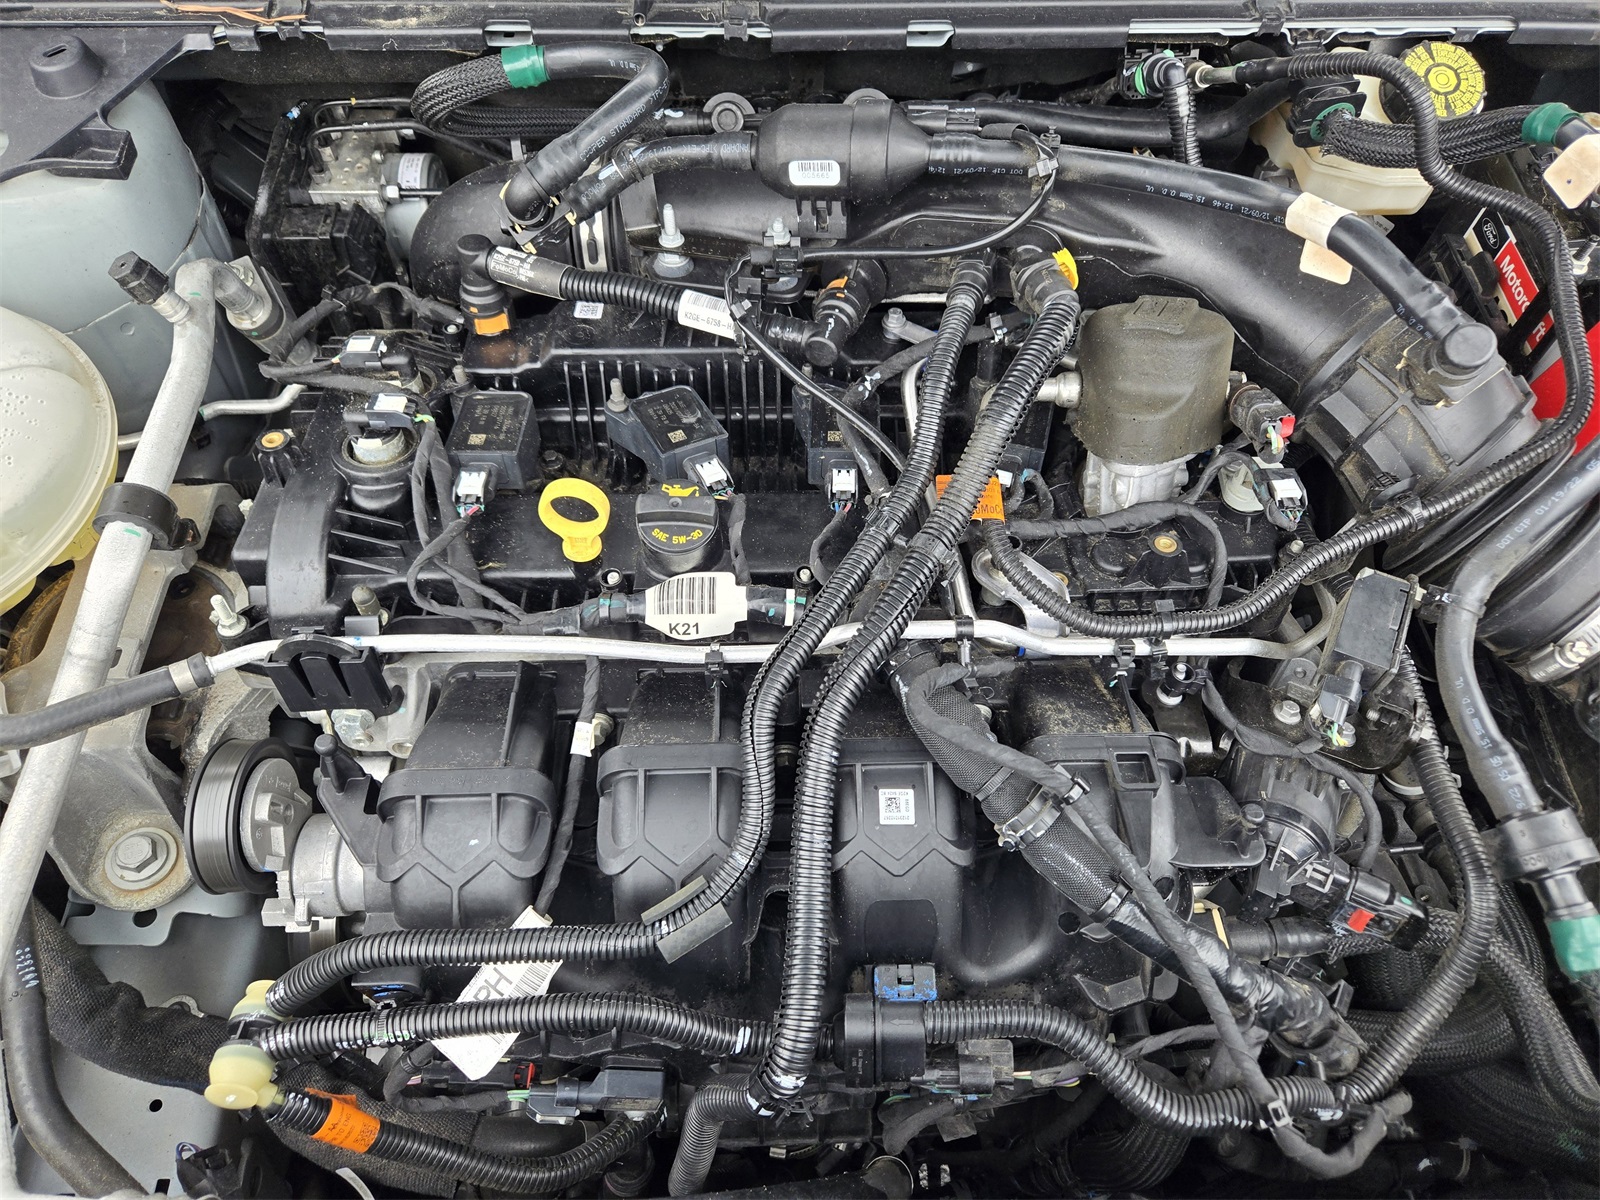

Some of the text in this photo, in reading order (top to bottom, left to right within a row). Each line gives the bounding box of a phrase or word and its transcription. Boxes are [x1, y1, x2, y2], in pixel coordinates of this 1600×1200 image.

[609, 103, 647, 137] STANDARD
[1212, 200, 1234, 210] 12:46
[1241, 206, 1270, 220] 12/09/21
[1484, 222, 1497, 245] Ford
[1496, 534, 1515, 550] DOT
[1534, 475, 1583, 516] 01/19/22
[651, 528, 703, 544] SAE 5W-30
[668, 622, 700, 636] K21
[1507, 786, 1527, 810] 9/22
